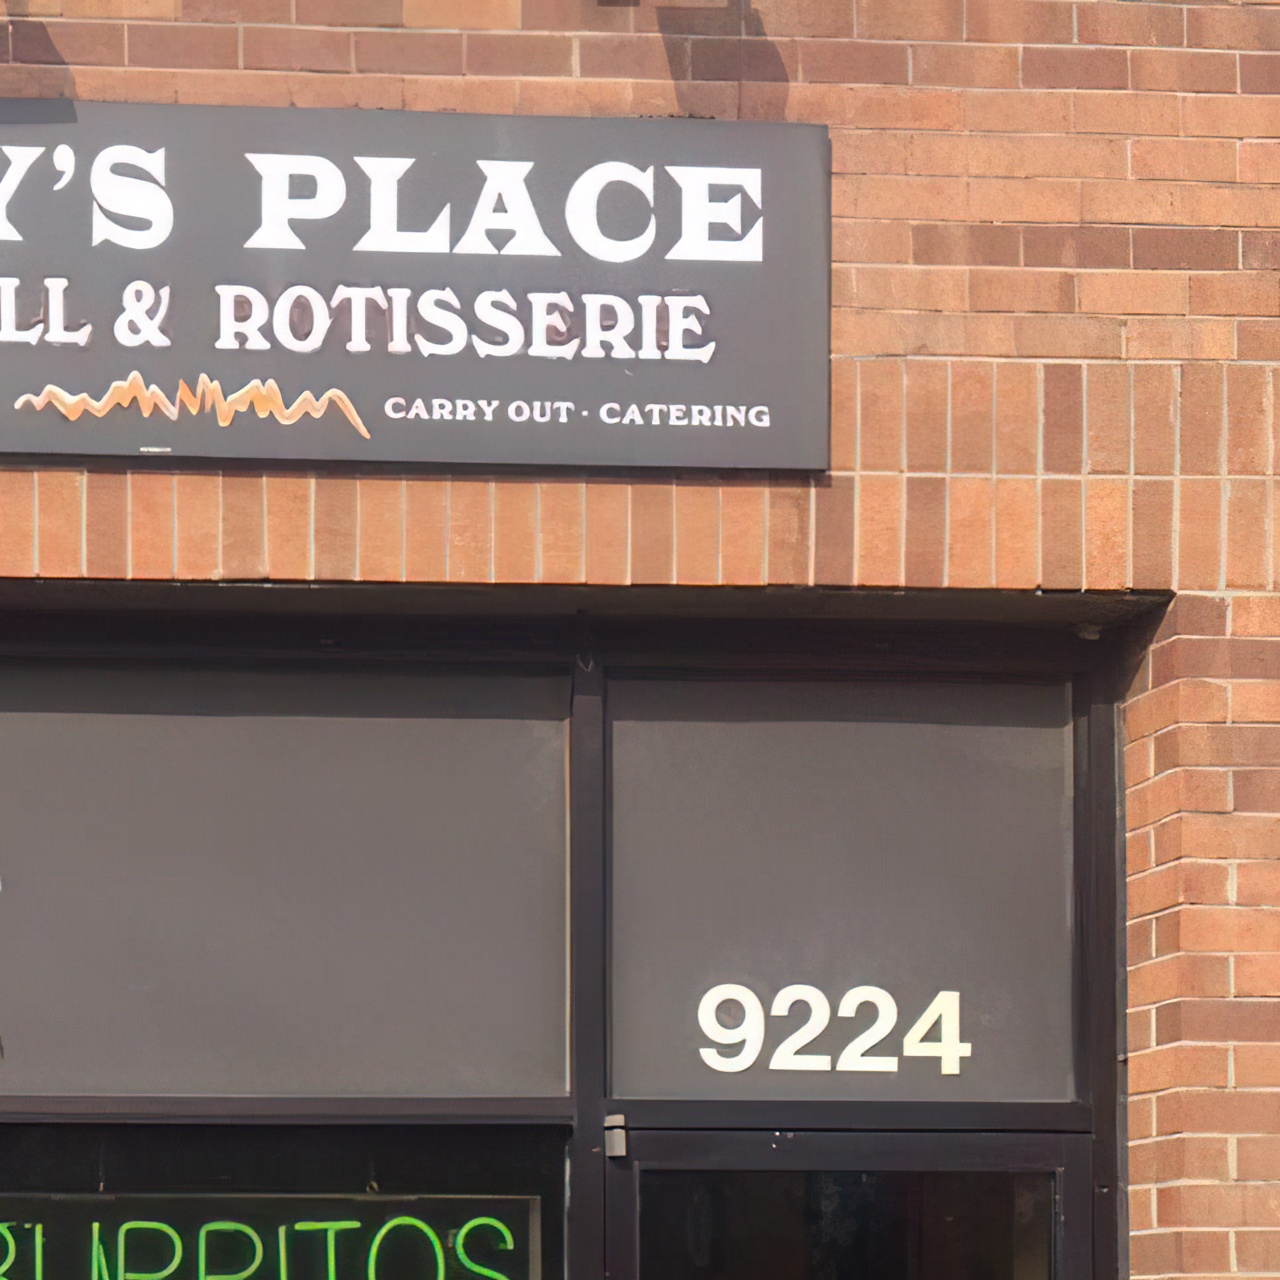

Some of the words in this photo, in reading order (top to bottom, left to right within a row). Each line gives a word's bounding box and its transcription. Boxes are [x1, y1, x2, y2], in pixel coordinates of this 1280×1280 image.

[243, 152, 764, 264] PLACE
[113, 279, 172, 347] &
[214, 284, 717, 364] ROTISSERIE
[383, 396, 500, 422] CARRY
[507, 399, 577, 424] OUT
[598, 402, 772, 428] CATERING
[696, 982, 973, 1076] 9224
